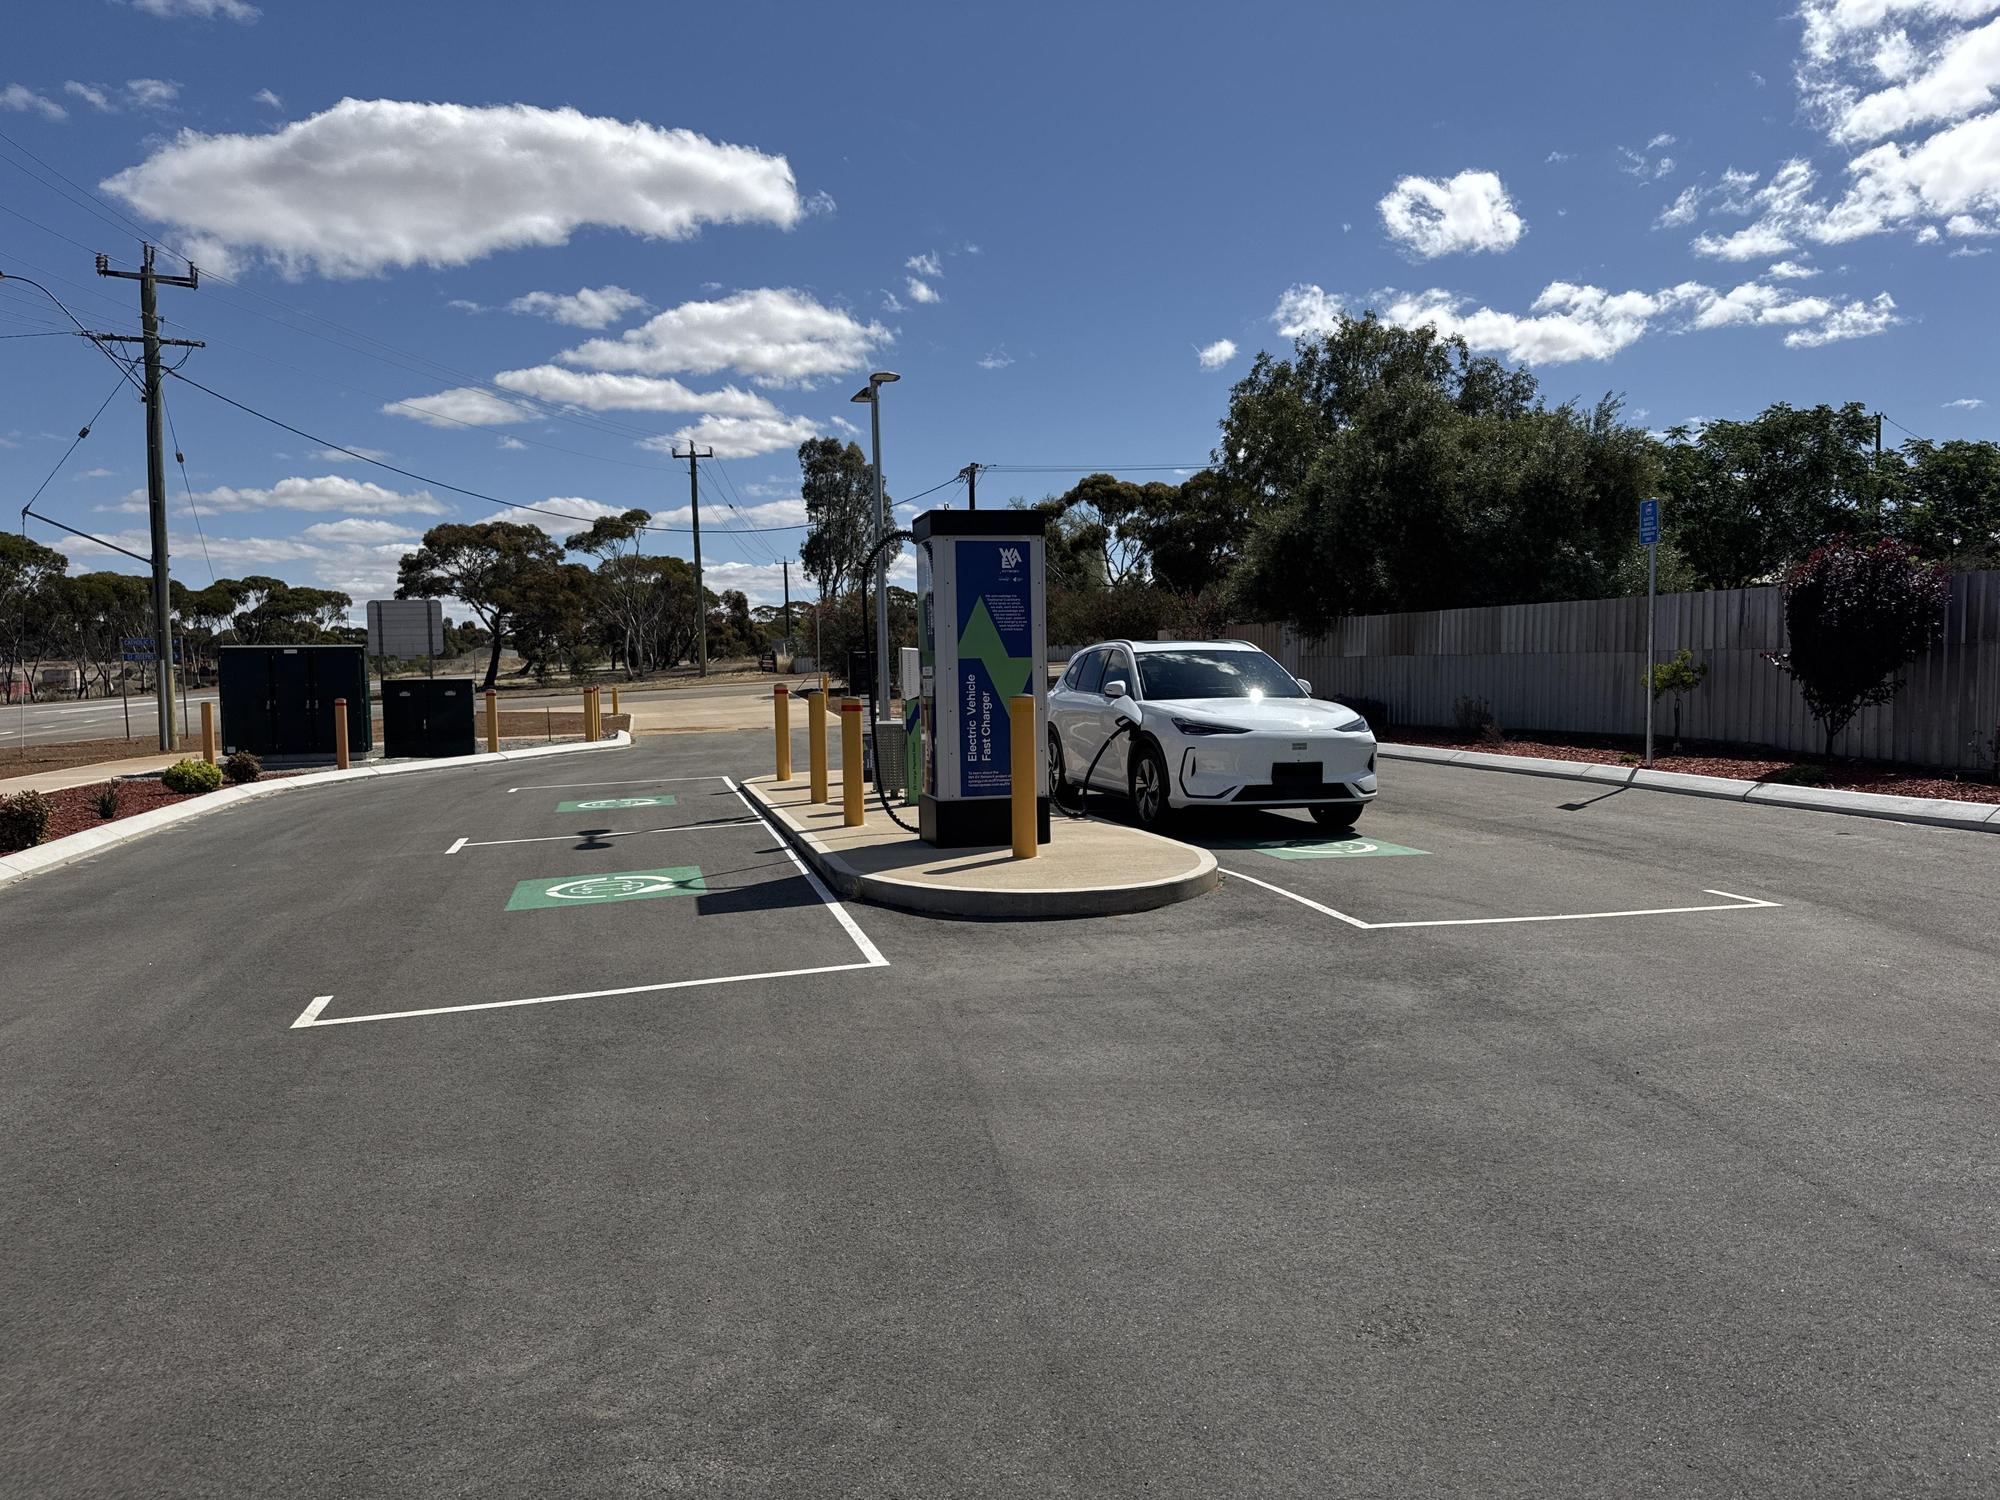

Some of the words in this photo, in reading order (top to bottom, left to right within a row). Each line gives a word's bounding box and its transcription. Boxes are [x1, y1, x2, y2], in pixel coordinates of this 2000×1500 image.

[966, 673, 976, 716] Vehicle
[981, 690, 993, 737] Charger
[967, 719, 977, 762] Electric
[981, 737, 992, 761] Fast
